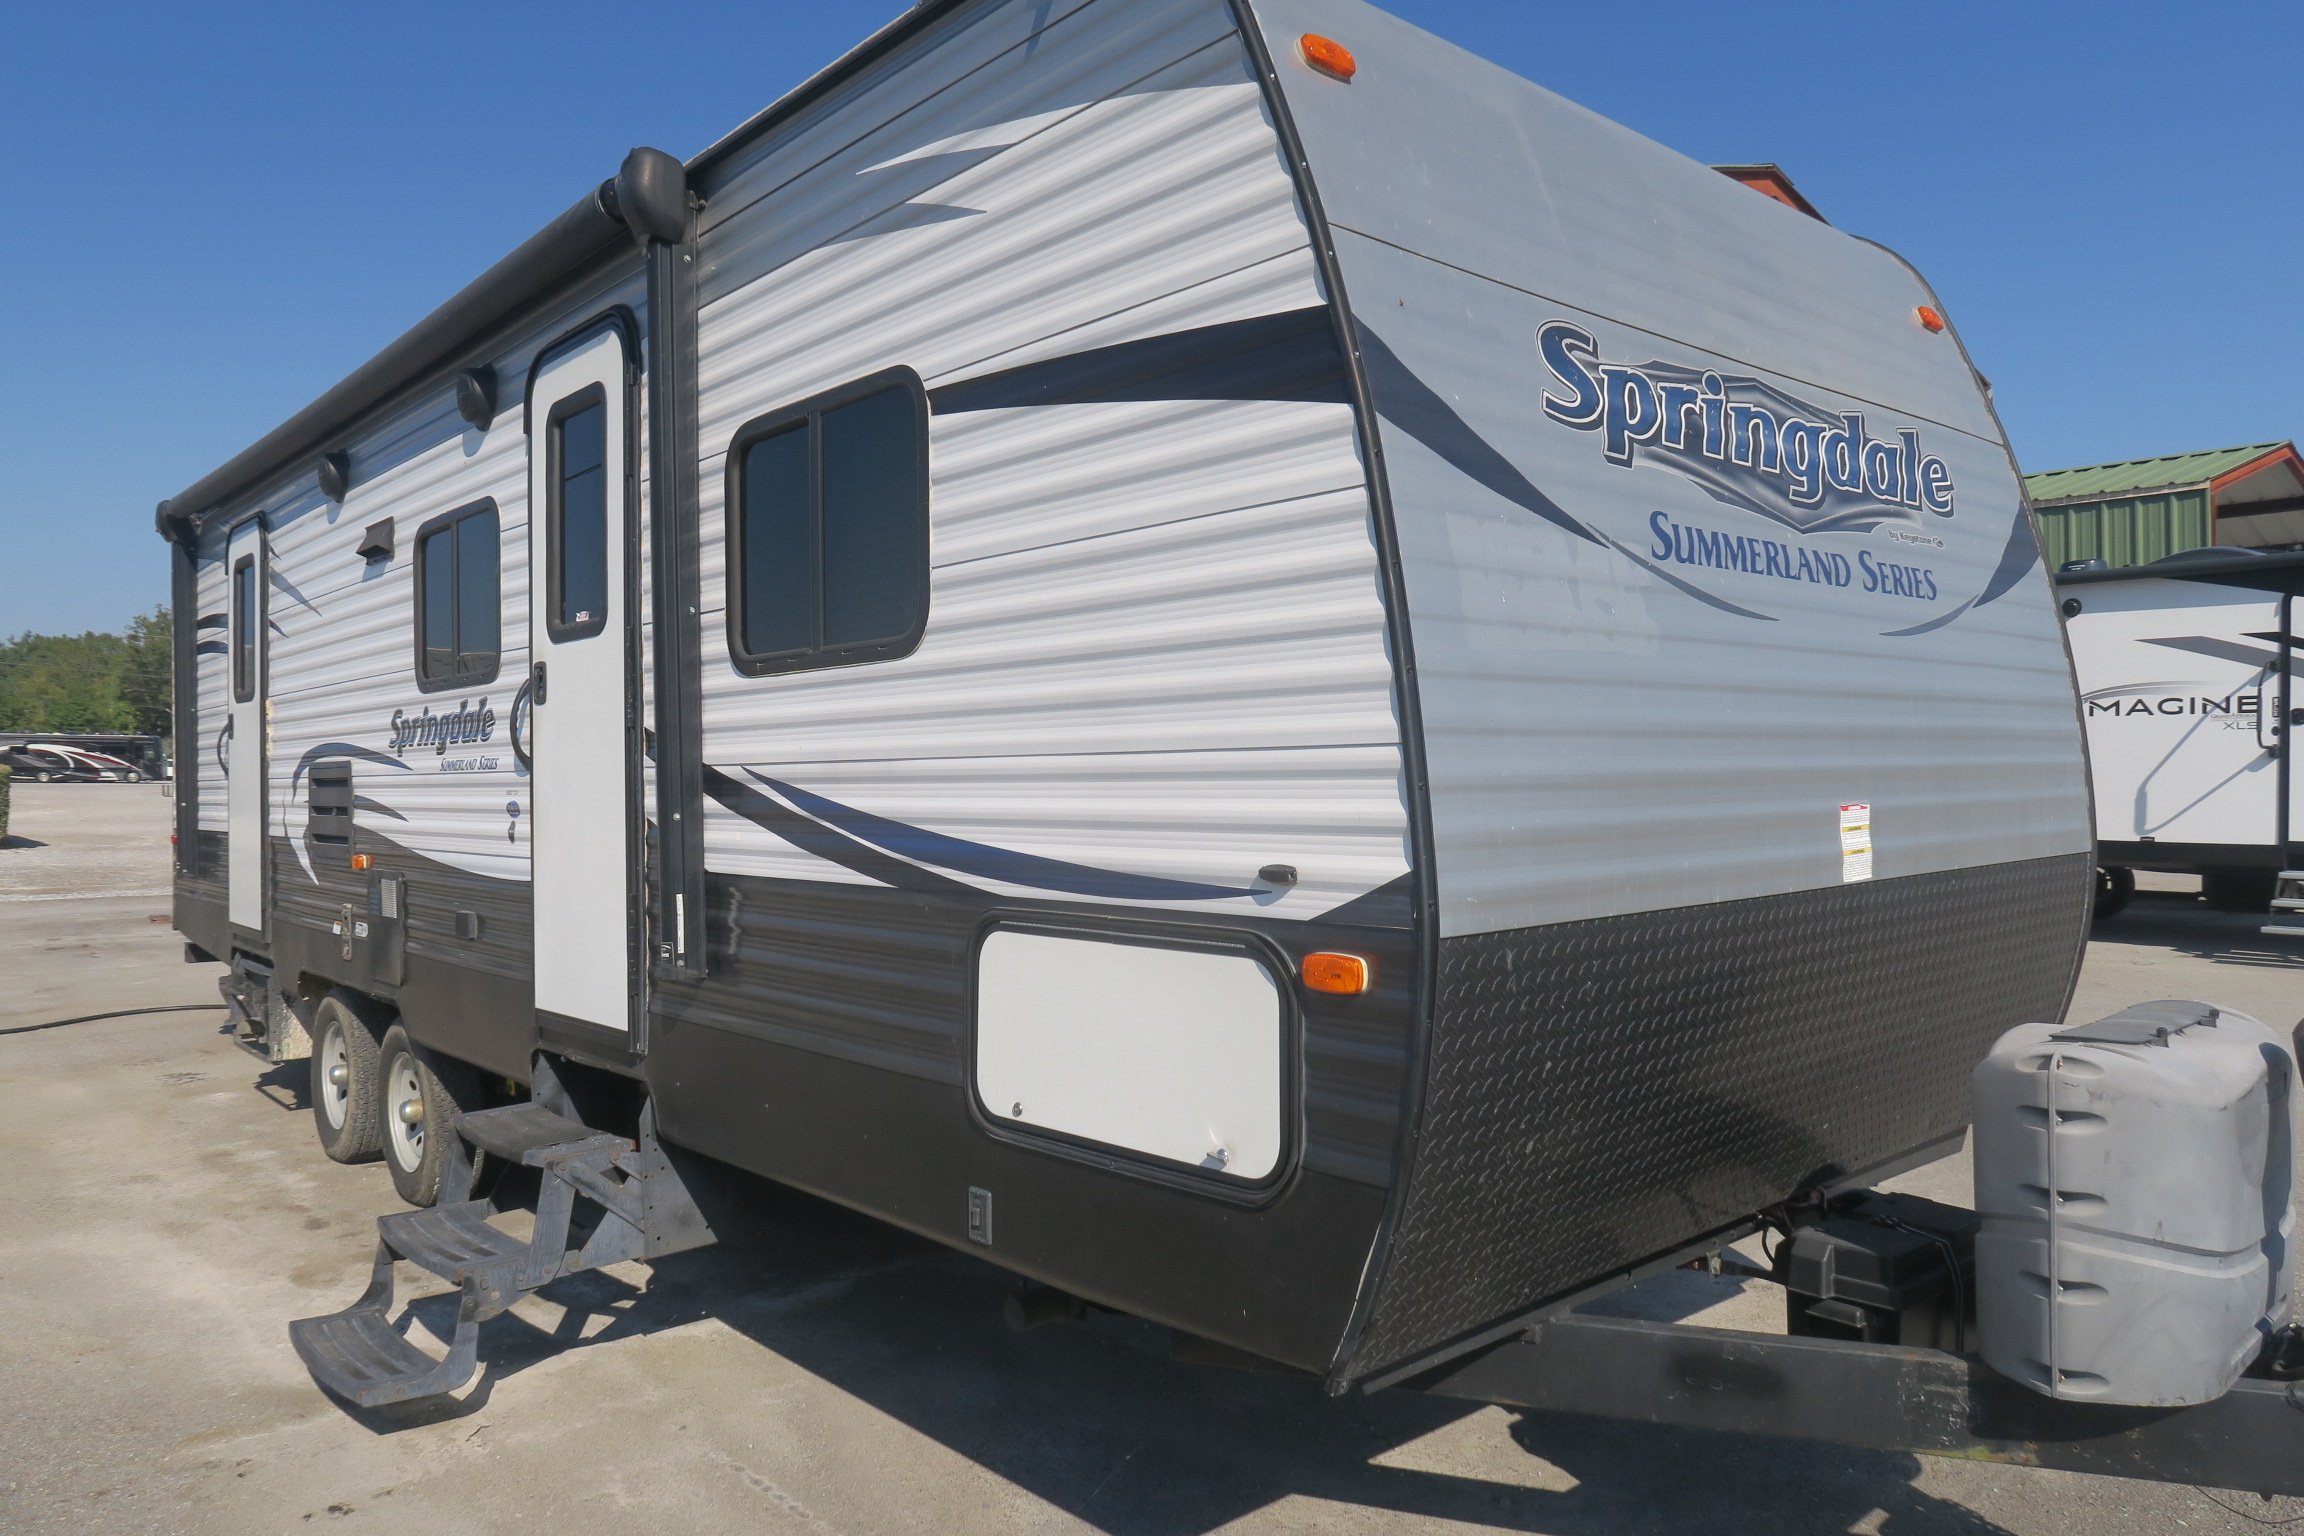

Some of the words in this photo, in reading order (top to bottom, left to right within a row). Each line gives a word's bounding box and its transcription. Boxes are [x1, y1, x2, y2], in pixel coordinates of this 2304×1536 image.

[1536, 319, 1956, 517] Springdale
[1649, 510, 1851, 588] SUMMERLAND
[1858, 549, 1938, 601] SERIES
[388, 696, 496, 757] Springdale
[2088, 696, 2259, 717] MAGINE
[2222, 721, 2259, 731] XLS
[440, 758, 477, 771] SUMMERLAND
[478, 756, 500, 770] SERIES
